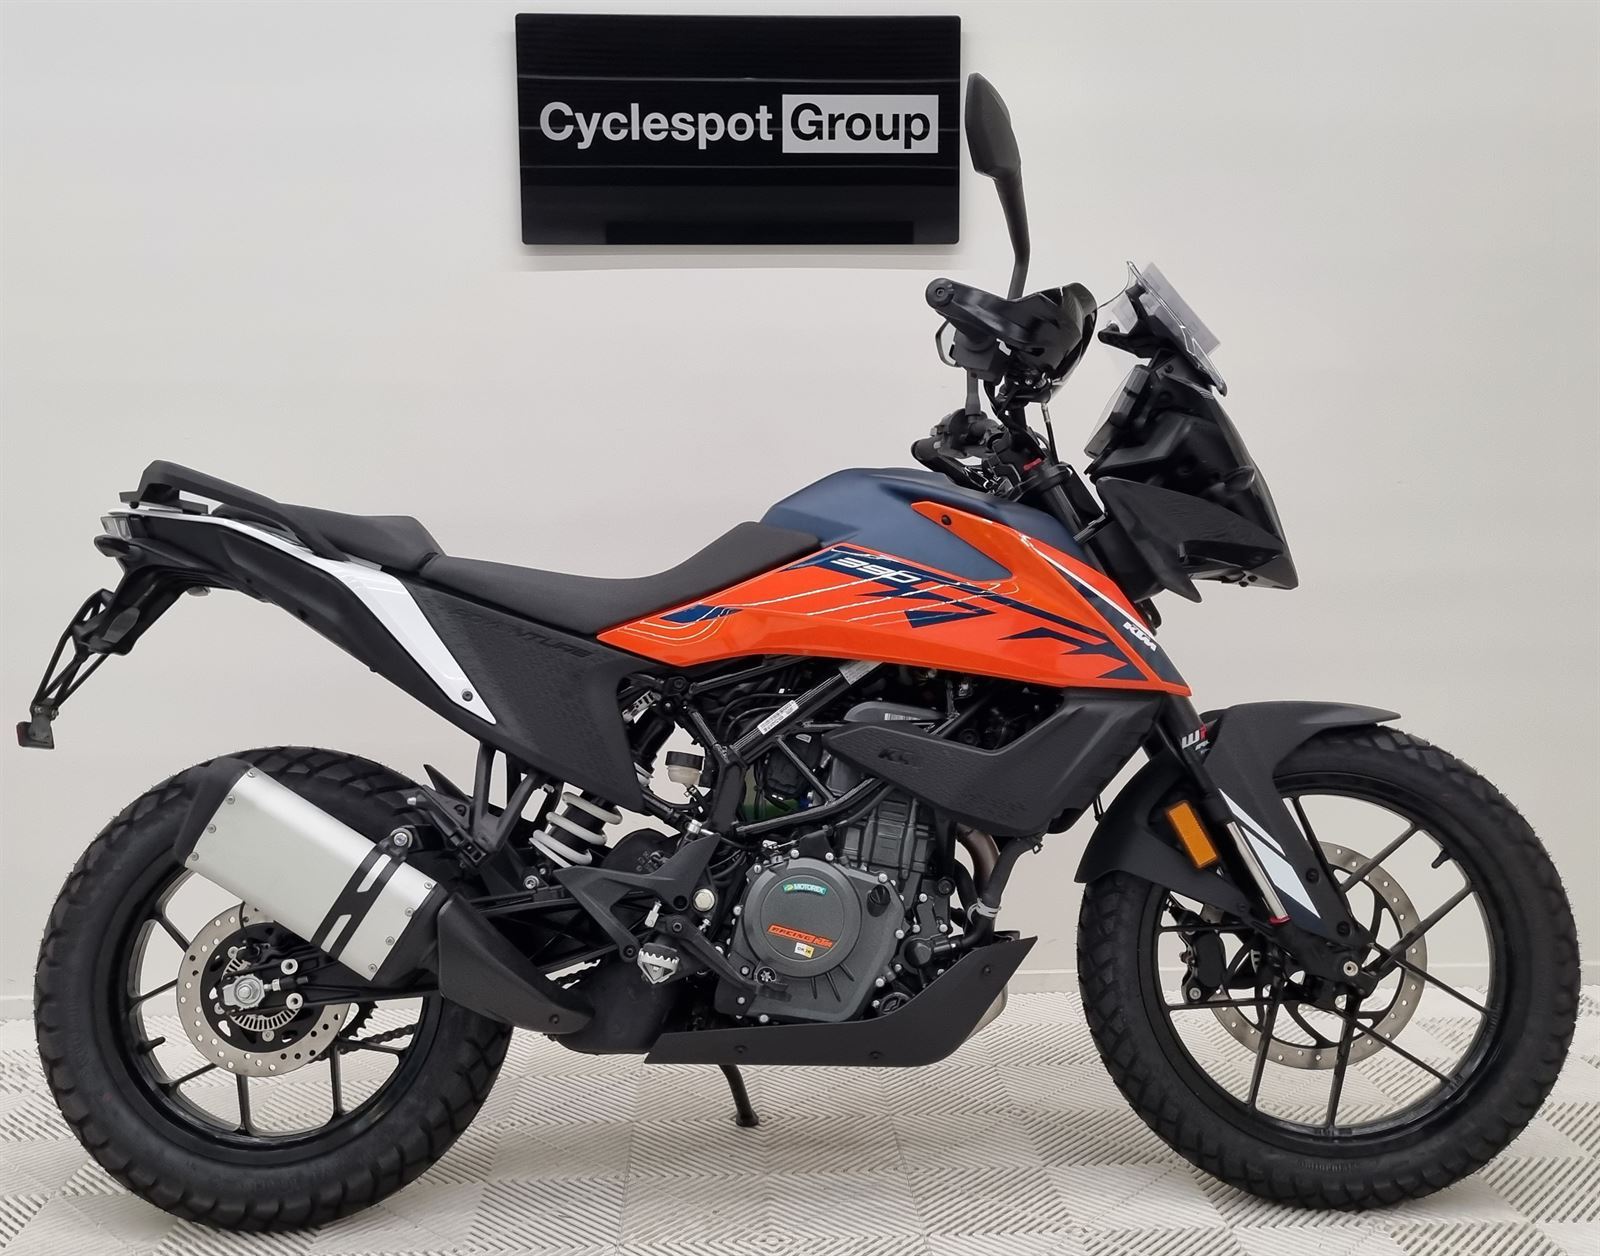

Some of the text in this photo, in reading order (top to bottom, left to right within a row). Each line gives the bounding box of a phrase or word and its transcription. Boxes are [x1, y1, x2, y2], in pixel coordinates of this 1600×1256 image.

[539, 101, 931, 150] Cyclespot Group
[830, 557, 922, 584] 390
[1123, 621, 1157, 652] KTM
[793, 883, 826, 895] MOTOREX
